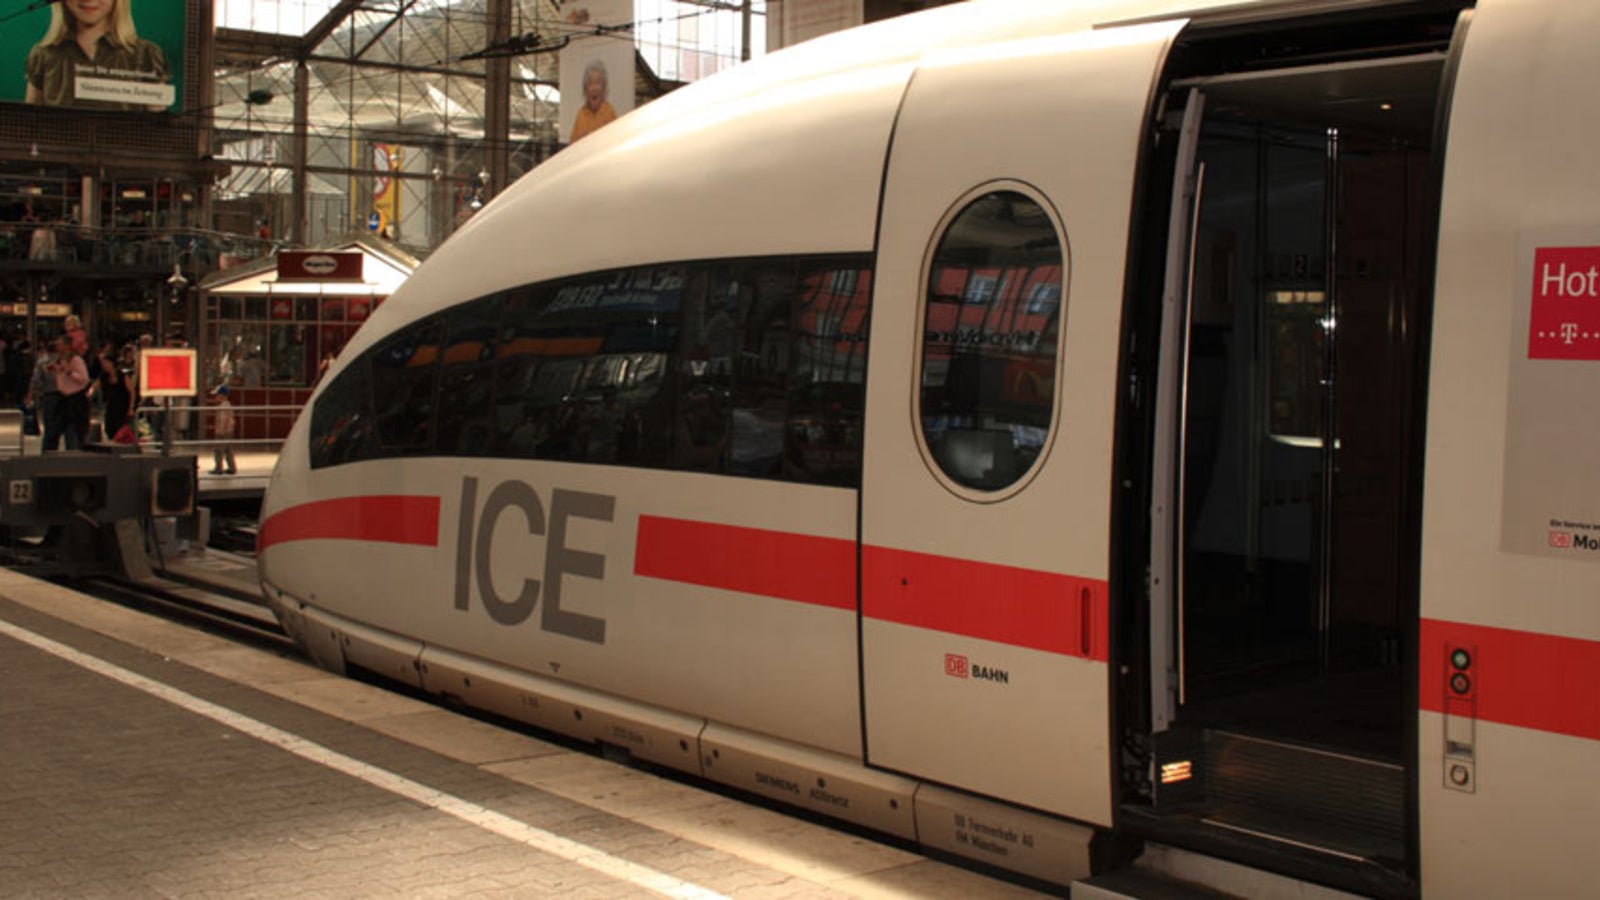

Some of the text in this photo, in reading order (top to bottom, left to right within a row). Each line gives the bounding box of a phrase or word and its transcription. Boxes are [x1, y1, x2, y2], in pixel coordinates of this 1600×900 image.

[1541, 262, 1599, 297] Hot
[13, 483, 29, 499] 22
[1573, 534, 1600, 550] Mo
[454, 475, 617, 646] ICE
[946, 656, 1009, 685] DB BAHN
[755, 772, 800, 795] SIEMENS
